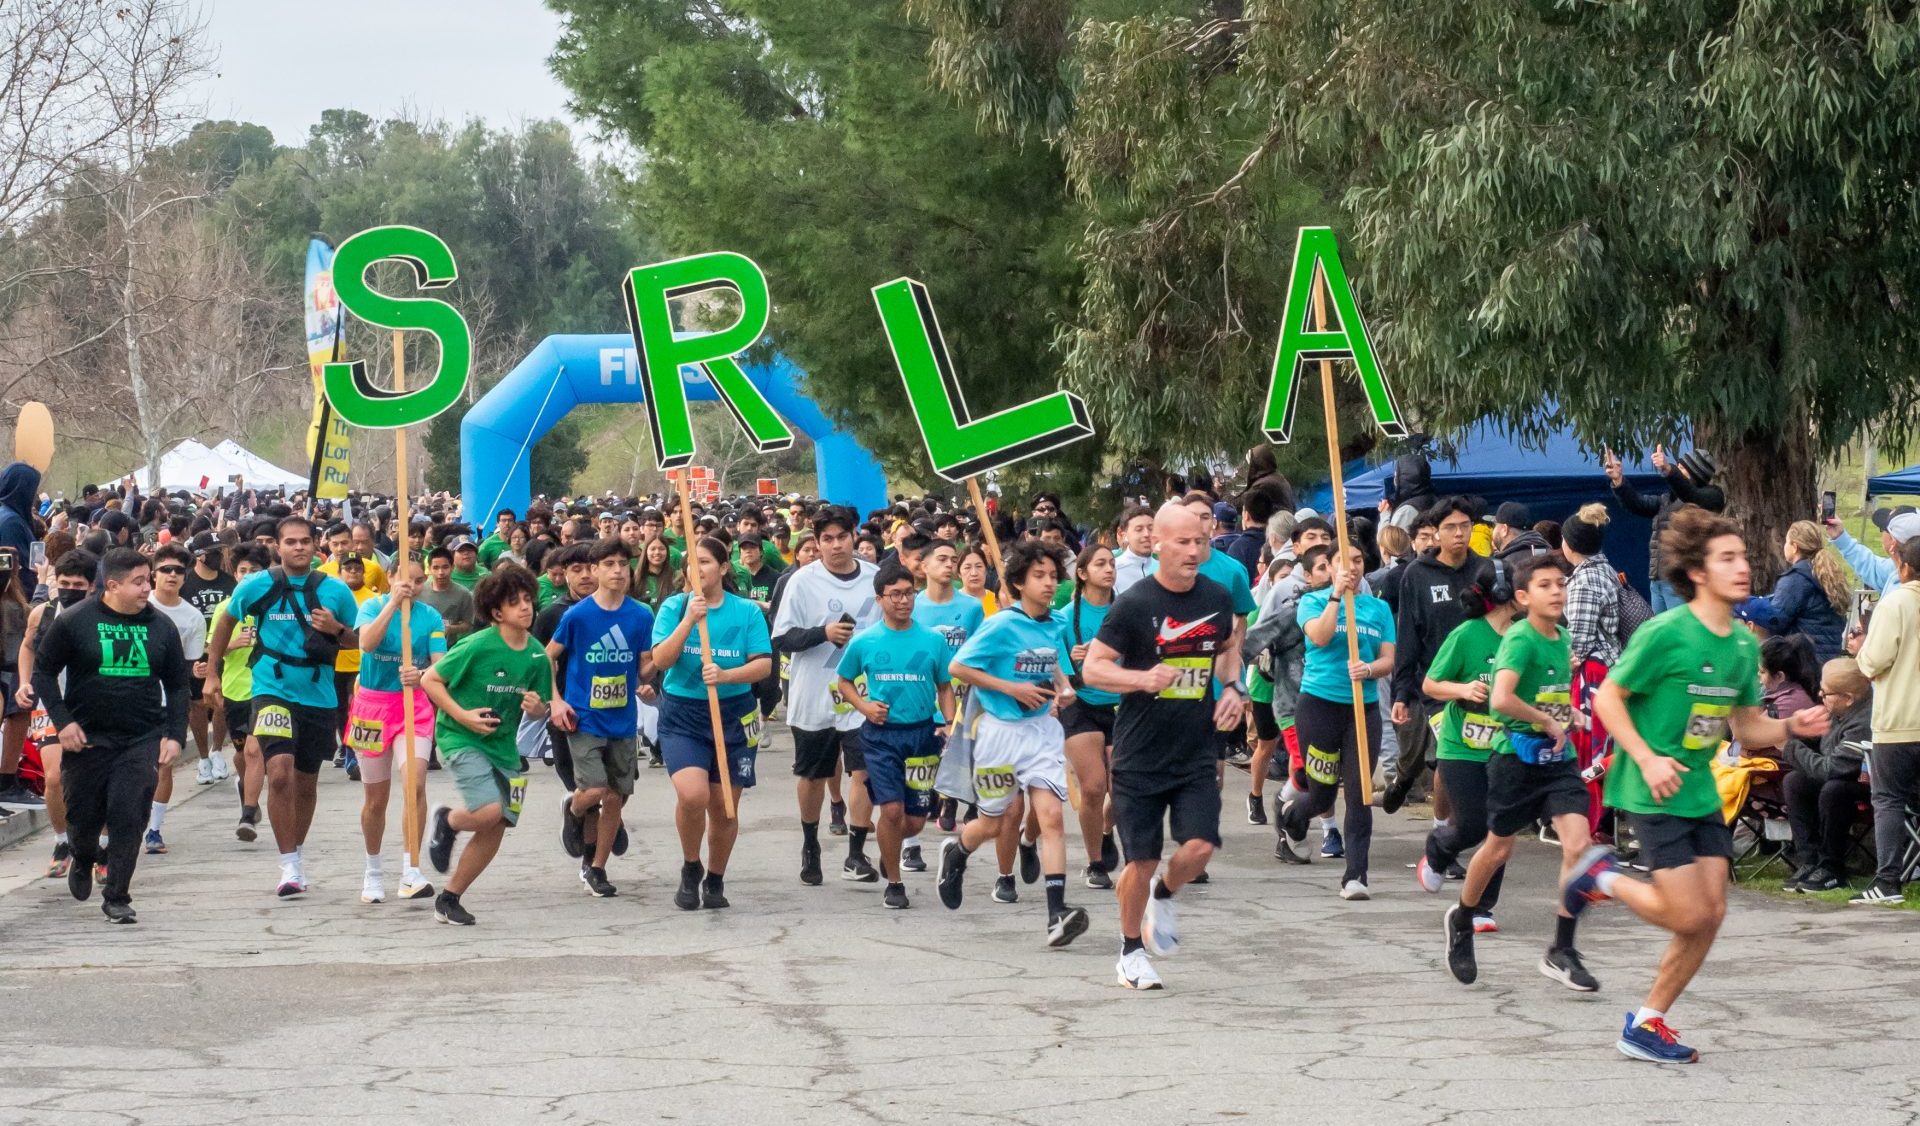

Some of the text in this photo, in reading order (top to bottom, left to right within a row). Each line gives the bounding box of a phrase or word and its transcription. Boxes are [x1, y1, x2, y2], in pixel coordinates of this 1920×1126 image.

[323, 225, 473, 430] S
[1261, 226, 1409, 444] A
[622, 251, 795, 471] R
[871, 277, 1095, 483] L
[192, 594, 225, 605] STAT
[585, 648, 634, 663] adidas
[718, 649, 731, 657] RUN
[592, 683, 626, 700] 6943
[258, 712, 291, 730] 7082
[907, 764, 938, 781] 707
